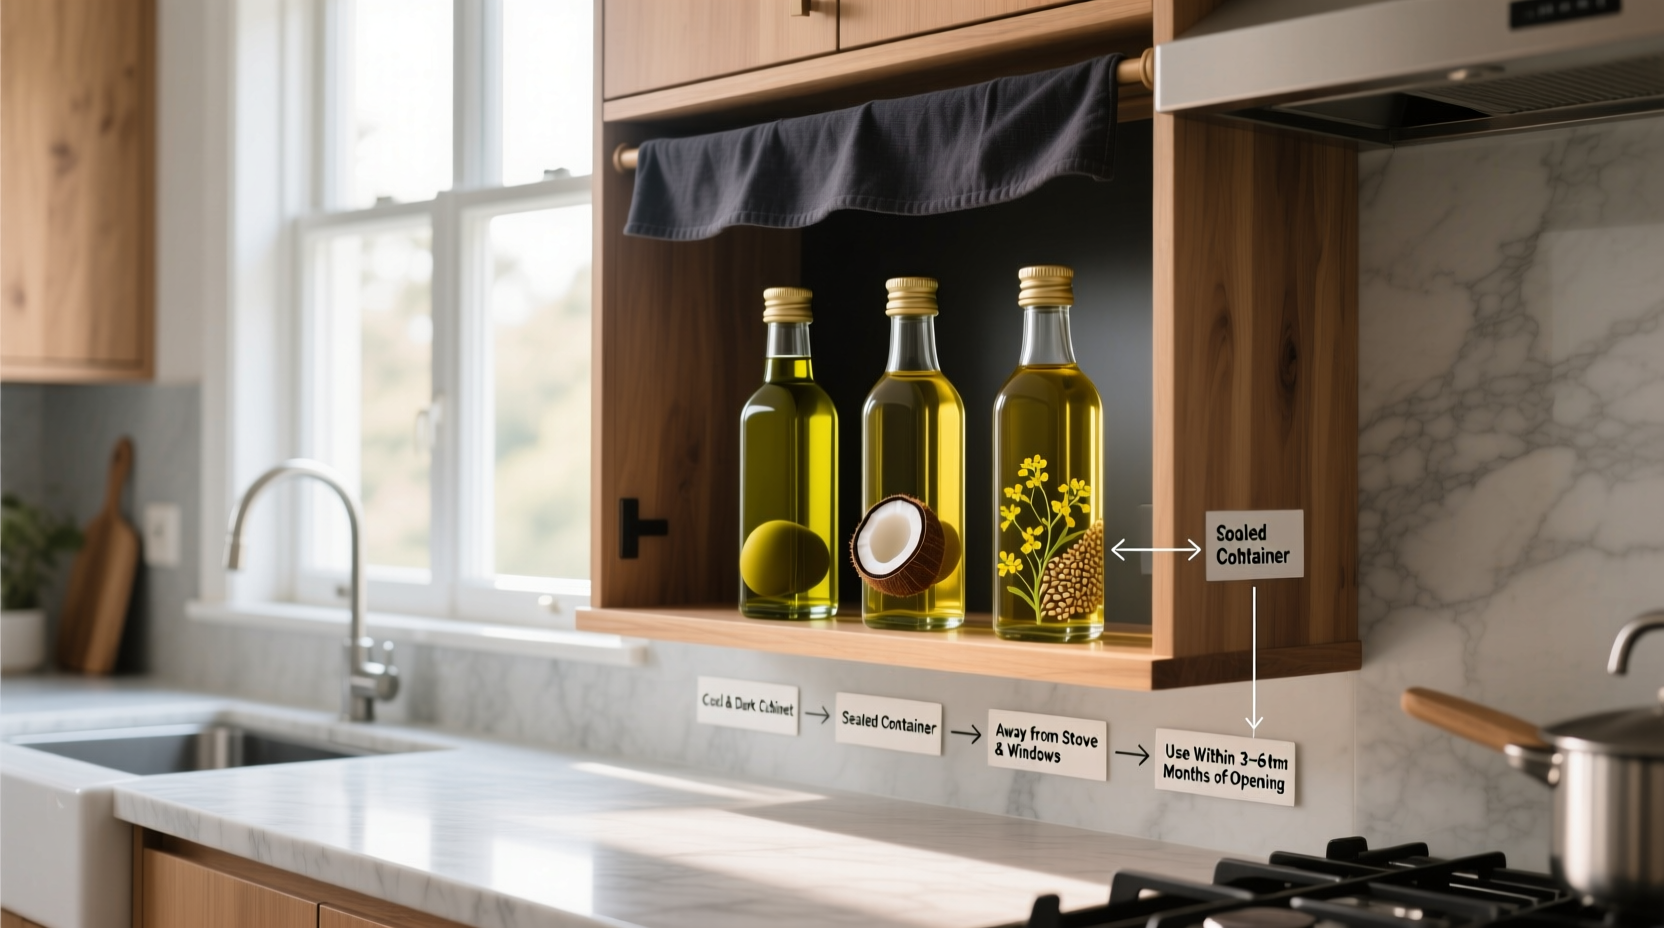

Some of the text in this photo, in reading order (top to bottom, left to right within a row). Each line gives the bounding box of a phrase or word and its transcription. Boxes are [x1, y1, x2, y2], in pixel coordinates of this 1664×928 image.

[842, 710, 937, 735] Sealed Container
[996, 722, 1099, 749] Away from Stove
[994, 741, 1061, 764] & Windows
[1165, 743, 1190, 760] Use
[1194, 746, 1235, 766] Within
[1163, 763, 1285, 795] Months of Opening
